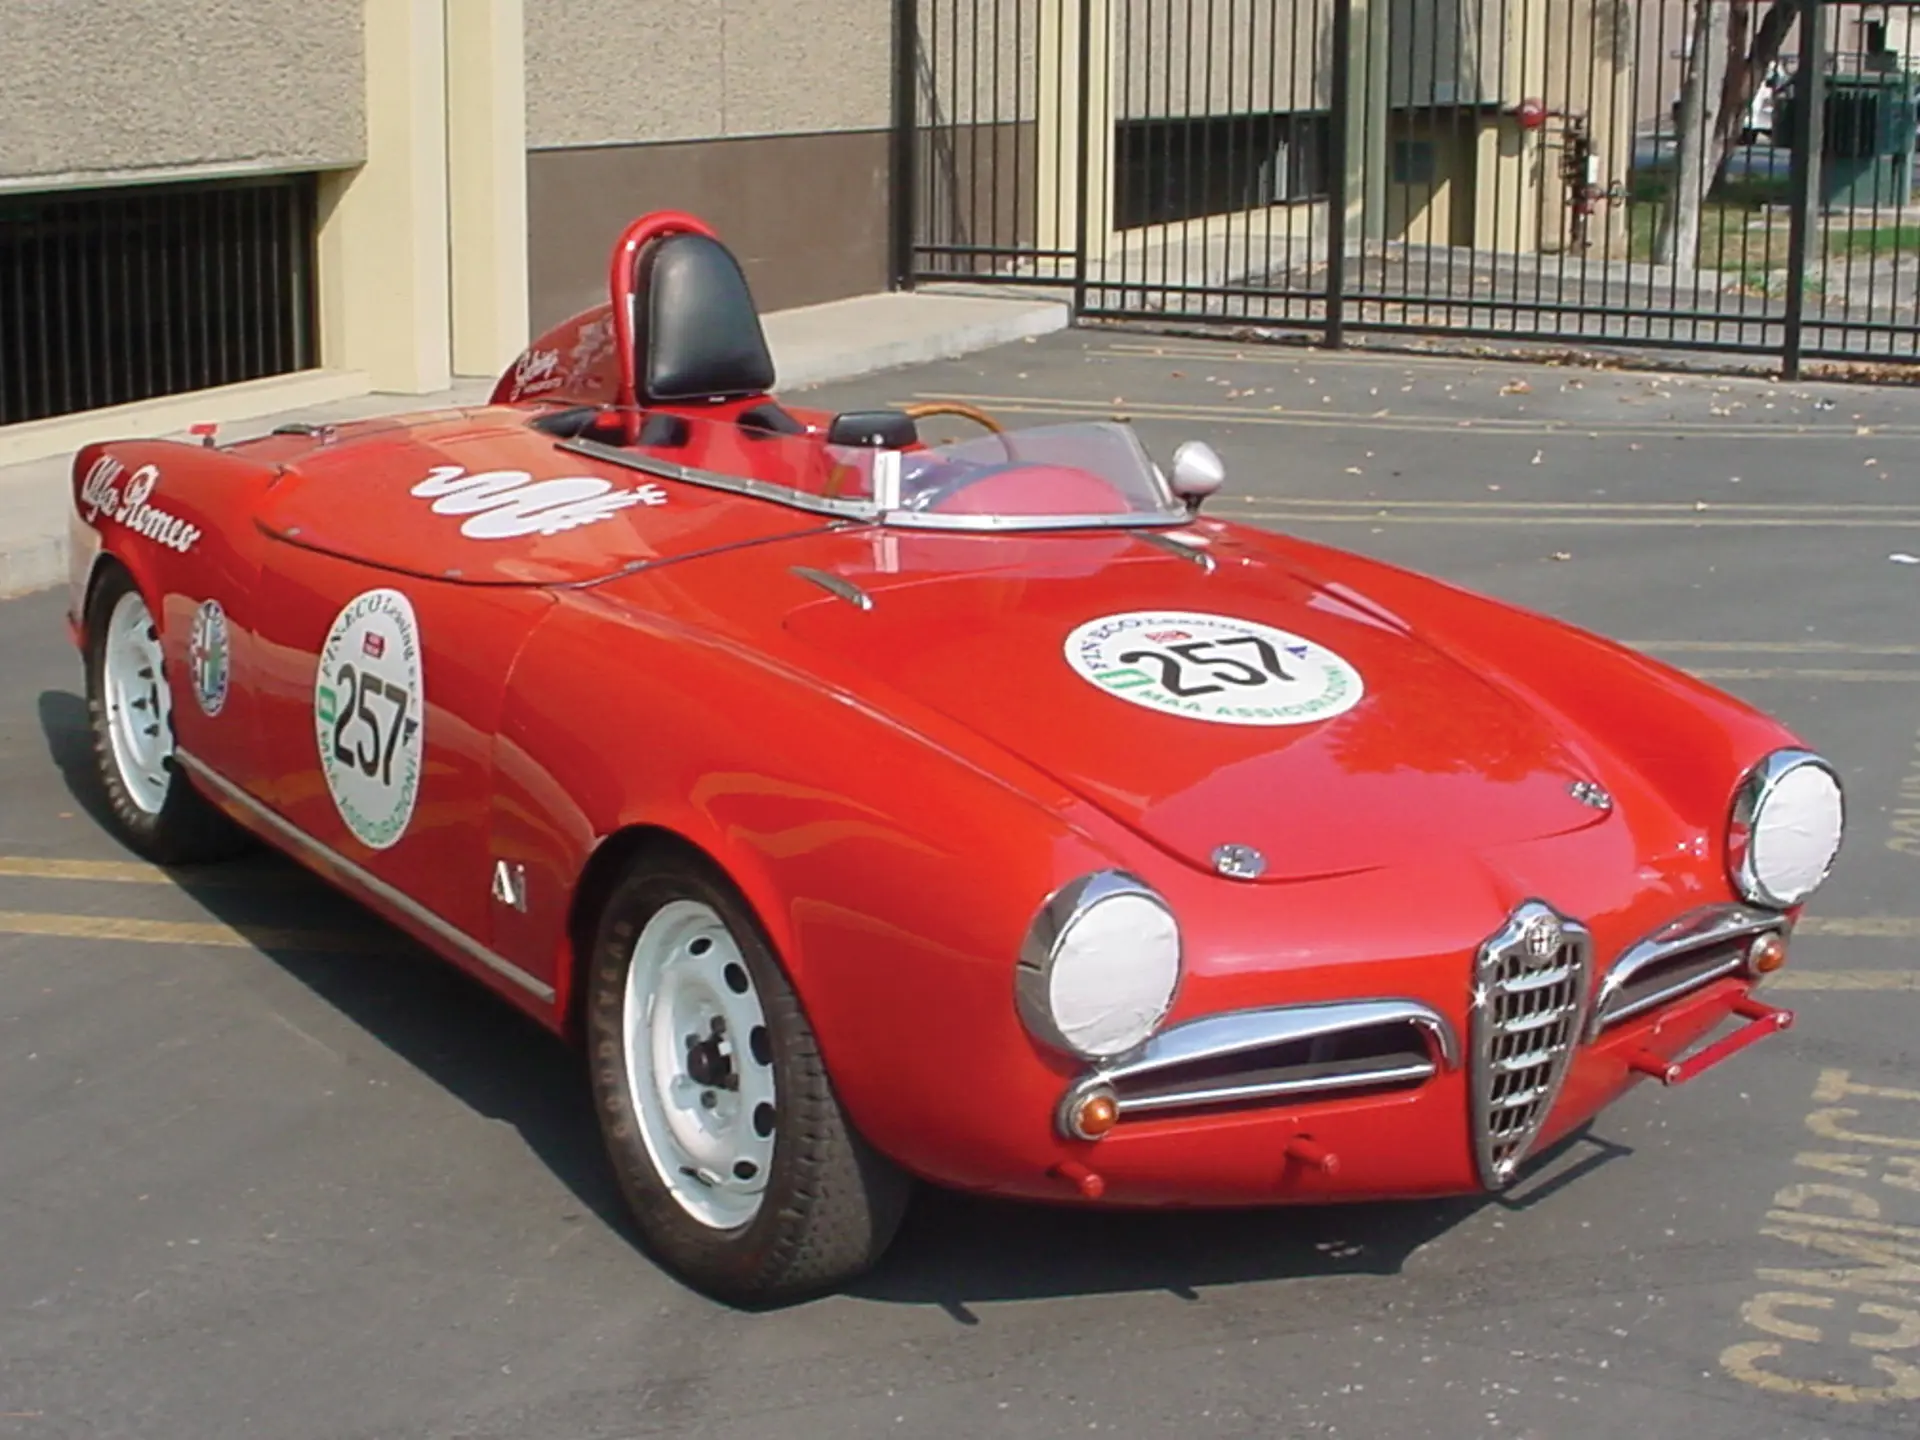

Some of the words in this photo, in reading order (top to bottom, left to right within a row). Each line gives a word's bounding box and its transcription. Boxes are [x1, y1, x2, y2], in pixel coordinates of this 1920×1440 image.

[114, 464, 202, 553] Romeo
[1118, 635, 1296, 698] 257
[333, 662, 409, 787] 257
